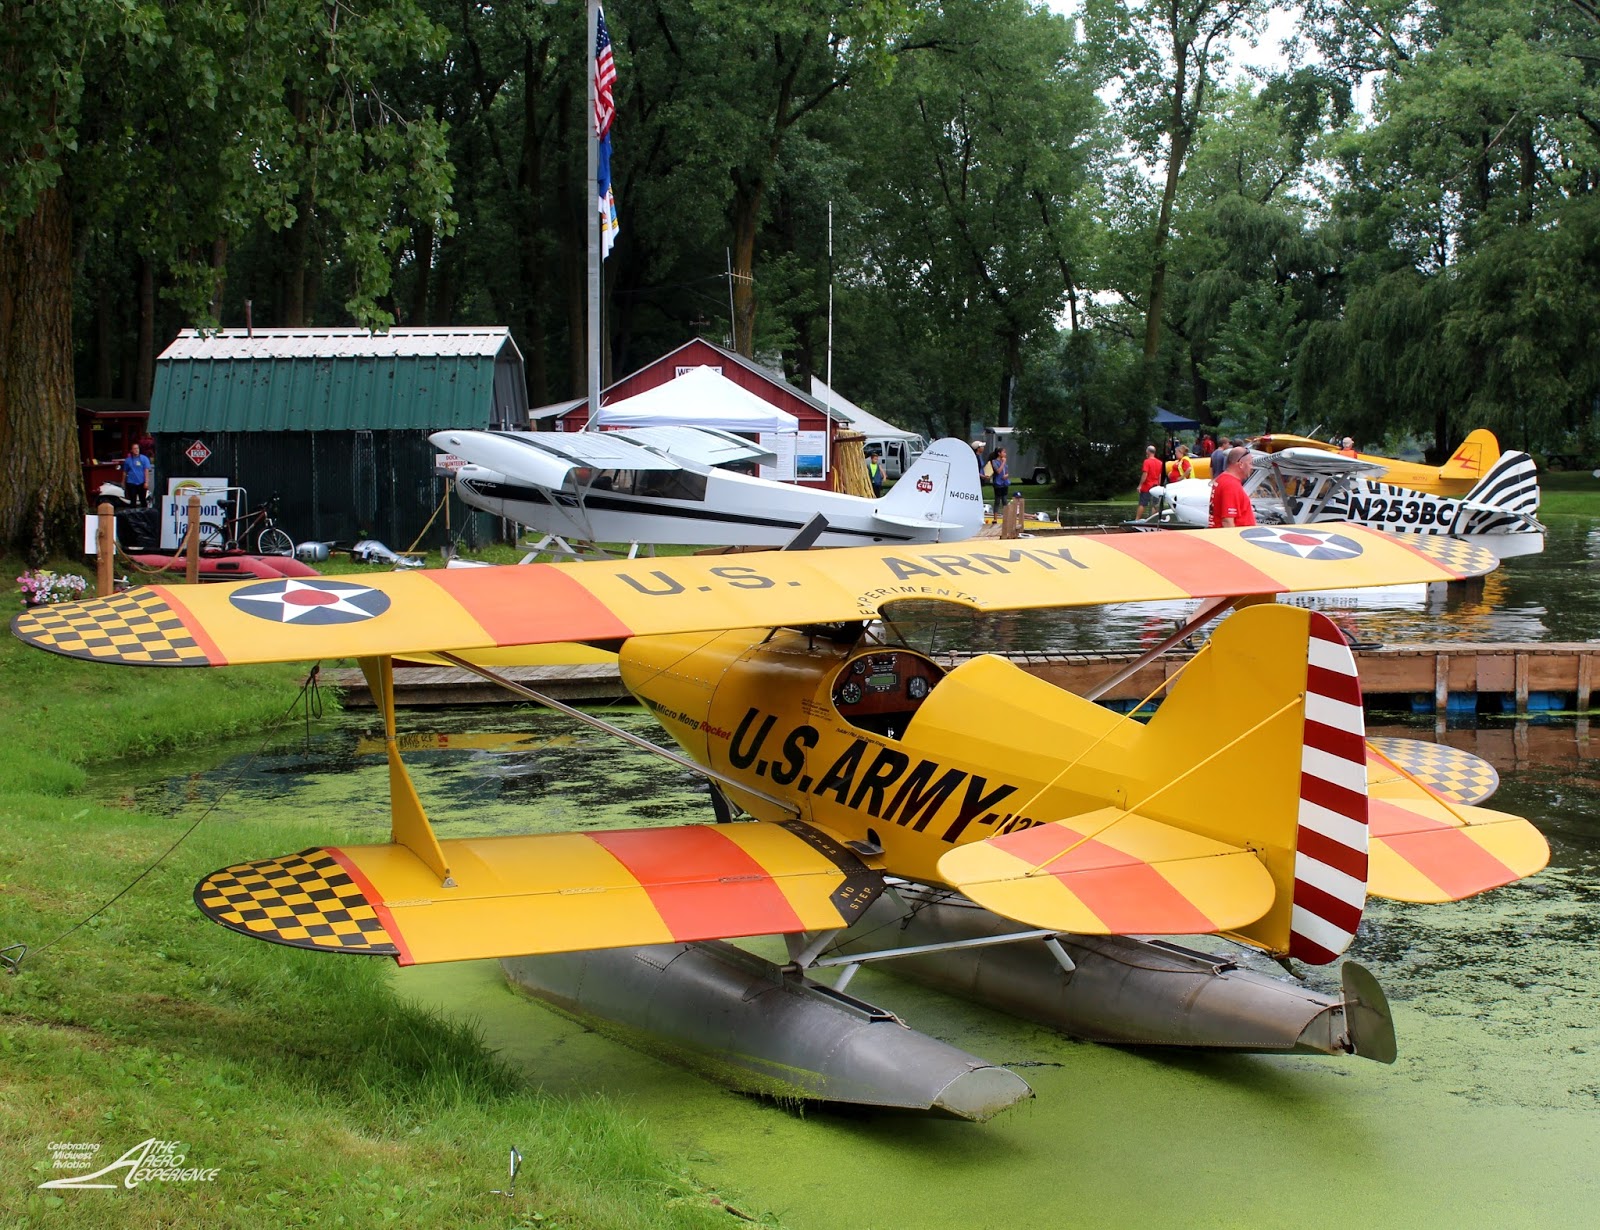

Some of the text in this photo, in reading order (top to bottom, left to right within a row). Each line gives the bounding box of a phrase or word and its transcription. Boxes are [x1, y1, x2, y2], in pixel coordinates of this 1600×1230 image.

[949, 490, 979, 501] N4068A
[170, 503, 218, 516] Pooon
[1347, 497, 1454, 526] N253BC
[881, 548, 1089, 580] ARMY
[857, 585, 988, 615] EXPERIMENTAL
[656, 703, 732, 740] Micro Mong Rocket
[840, 886, 855, 899] NO
[849, 887, 872, 910] STEP
